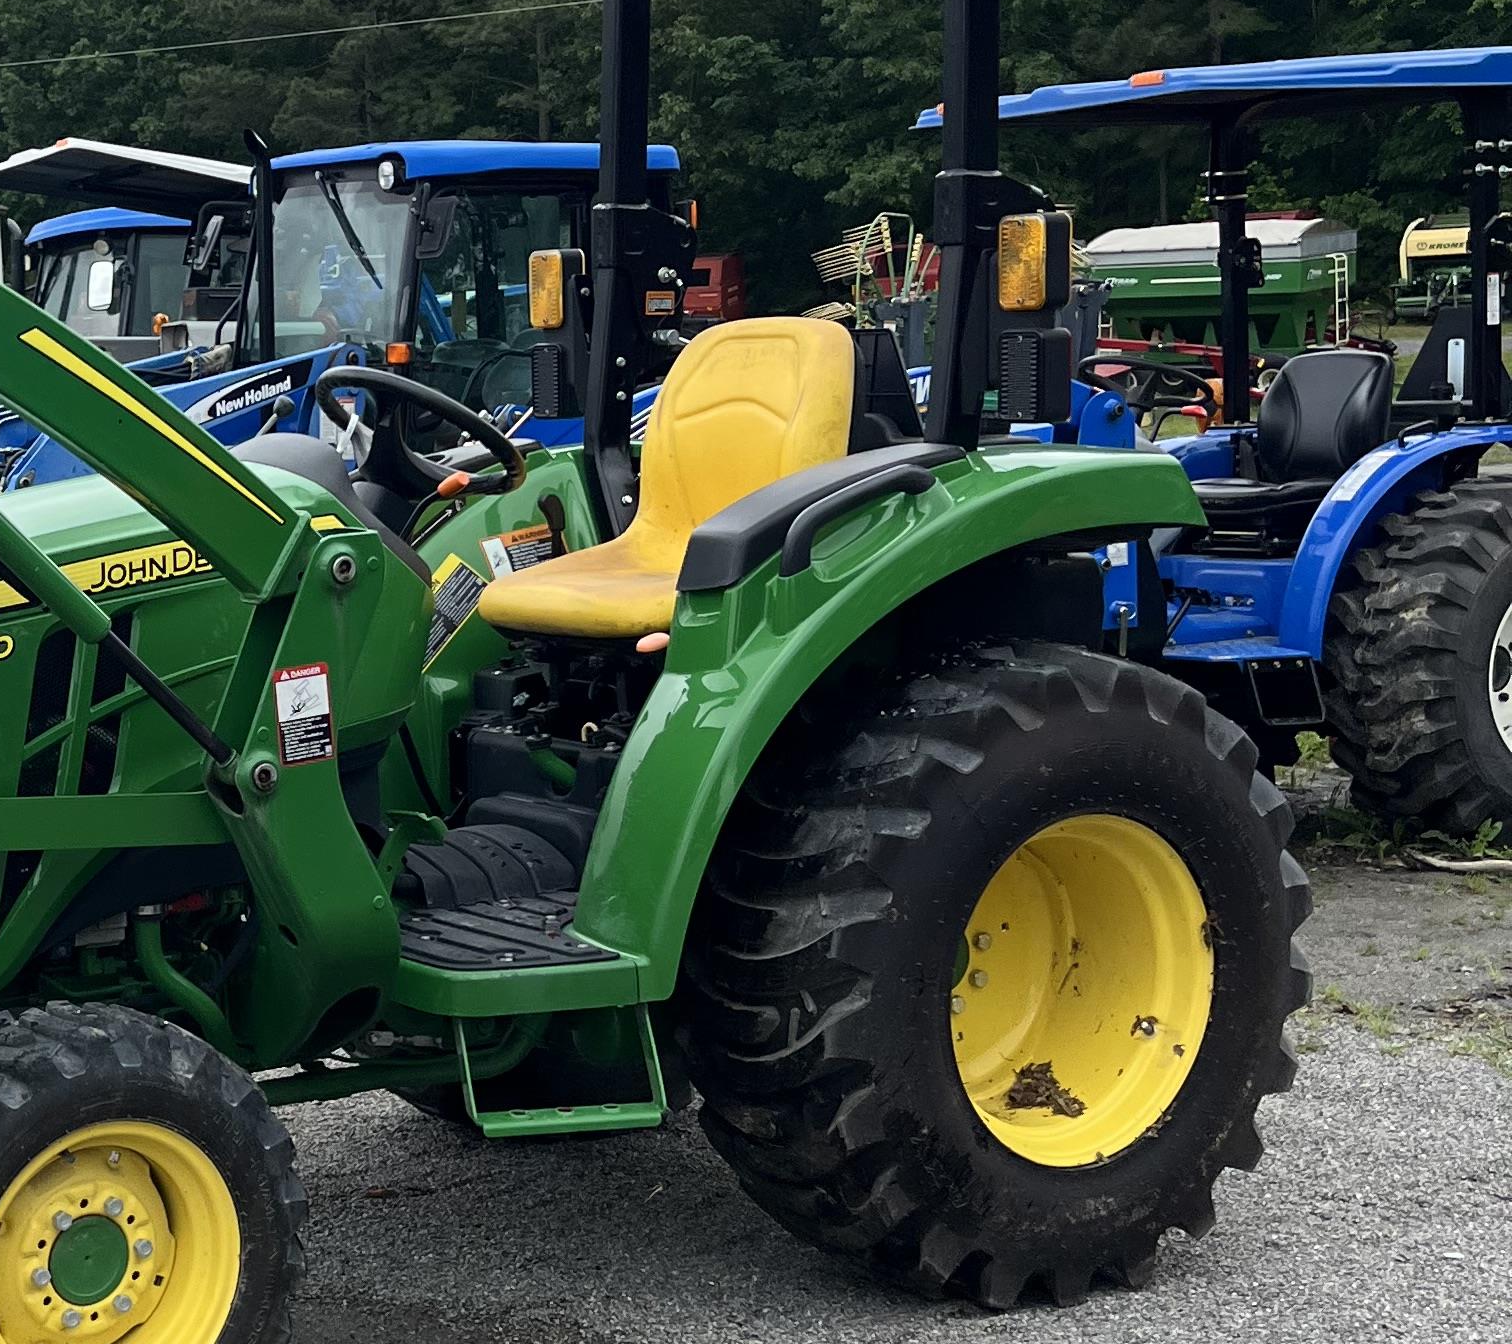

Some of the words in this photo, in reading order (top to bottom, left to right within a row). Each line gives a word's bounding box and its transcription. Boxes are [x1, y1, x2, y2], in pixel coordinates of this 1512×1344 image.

[215, 394, 244, 417] New
[244, 375, 292, 406] Holland
[90, 554, 168, 592] JOHN
[290, 666, 321, 679] DANGER
